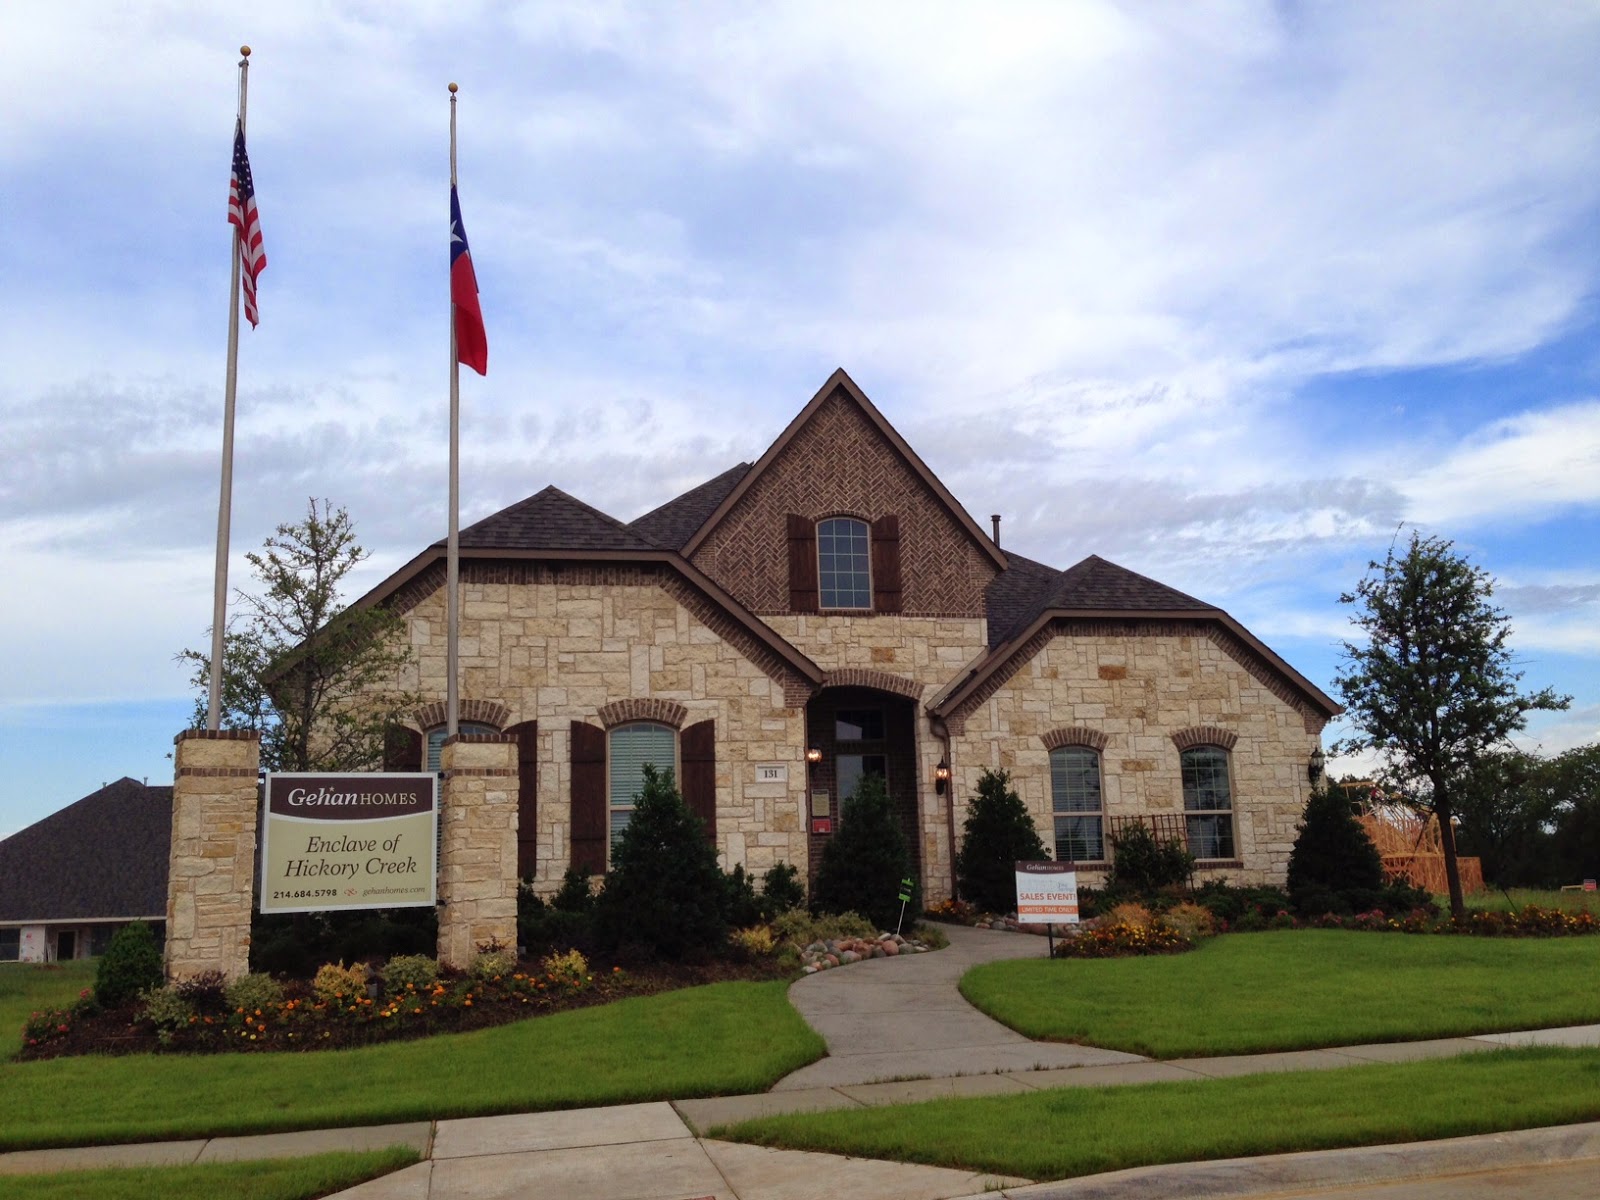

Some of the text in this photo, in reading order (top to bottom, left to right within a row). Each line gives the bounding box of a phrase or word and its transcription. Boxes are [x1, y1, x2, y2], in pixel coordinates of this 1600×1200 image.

[764, 770, 778, 778] 131
[288, 787, 417, 806] Gehan HOMES
[305, 834, 402, 853] Enclave of
[284, 857, 417, 879] Hickory Creek
[273, 886, 425, 899] 214.684.5798 gehanhomes.com
